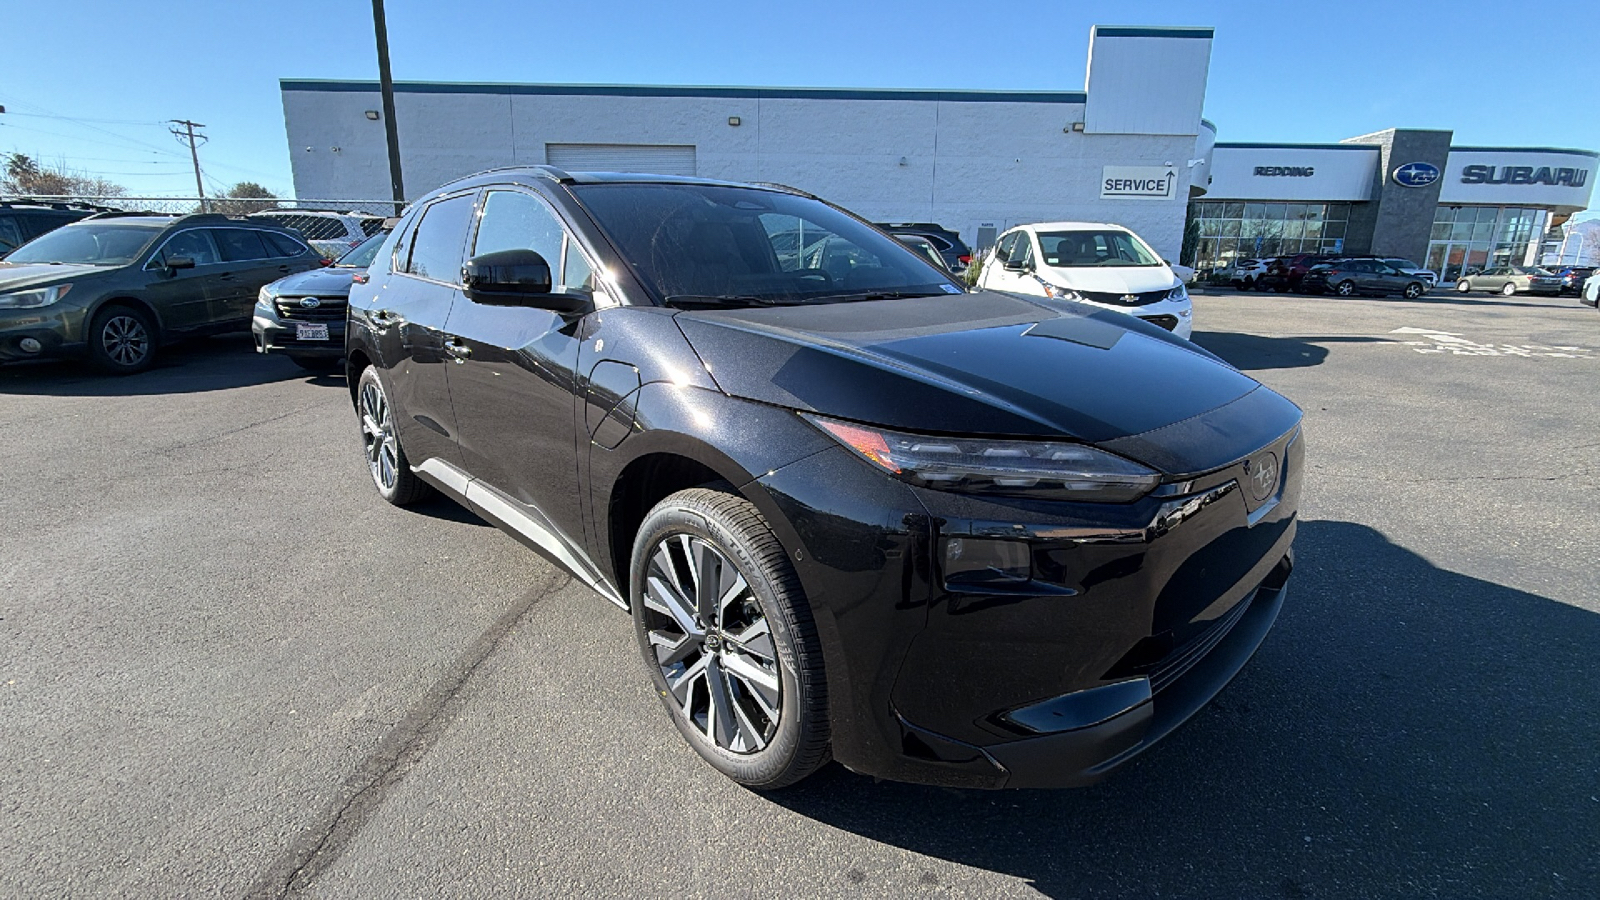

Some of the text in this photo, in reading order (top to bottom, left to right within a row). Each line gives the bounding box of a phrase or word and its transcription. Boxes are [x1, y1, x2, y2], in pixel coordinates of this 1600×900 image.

[1253, 166, 1315, 177] REDDING
[1461, 165, 1588, 187] SUBARU
[1104, 179, 1165, 191] SERVICE
